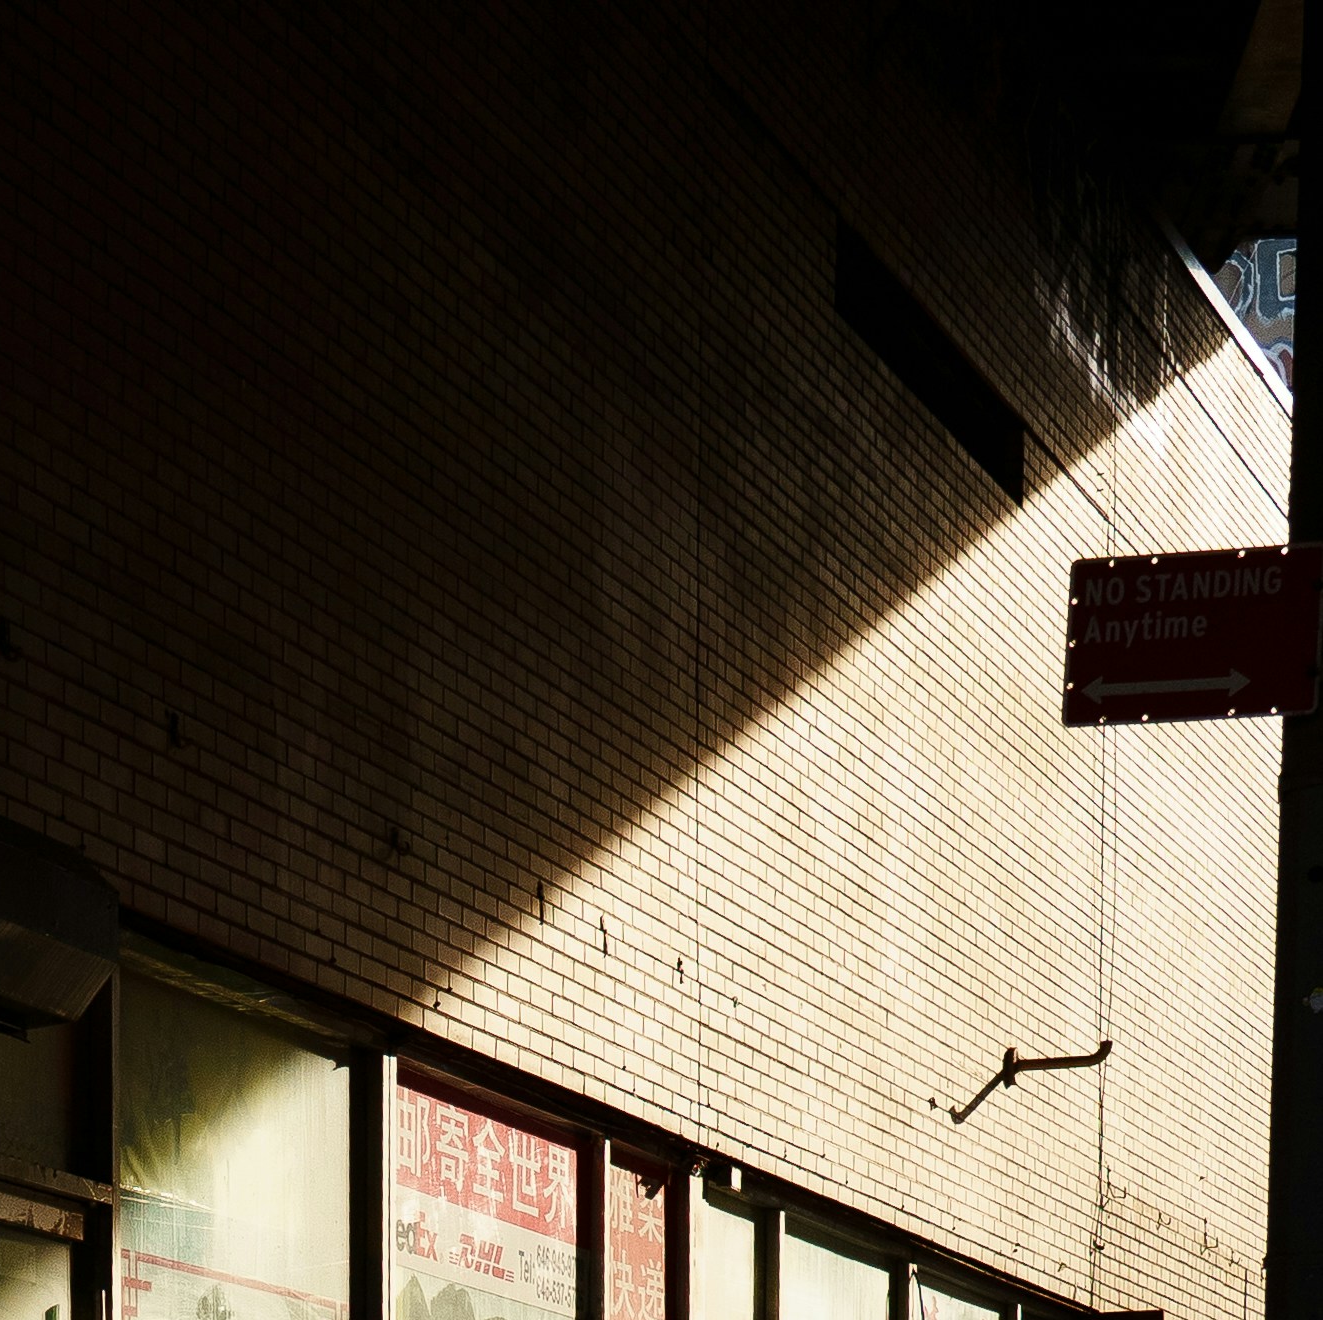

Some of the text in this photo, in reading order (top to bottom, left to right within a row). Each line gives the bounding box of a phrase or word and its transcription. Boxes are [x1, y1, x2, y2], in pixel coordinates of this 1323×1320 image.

[1085, 566, 1282, 606] NO STANDING
[1083, 610, 1208, 648] Anytime
[396, 1086, 575, 1230] 邮寄全世界
[455, 1232, 511, 1281] DHL
[518, 1249, 536, 1286] Tel:
